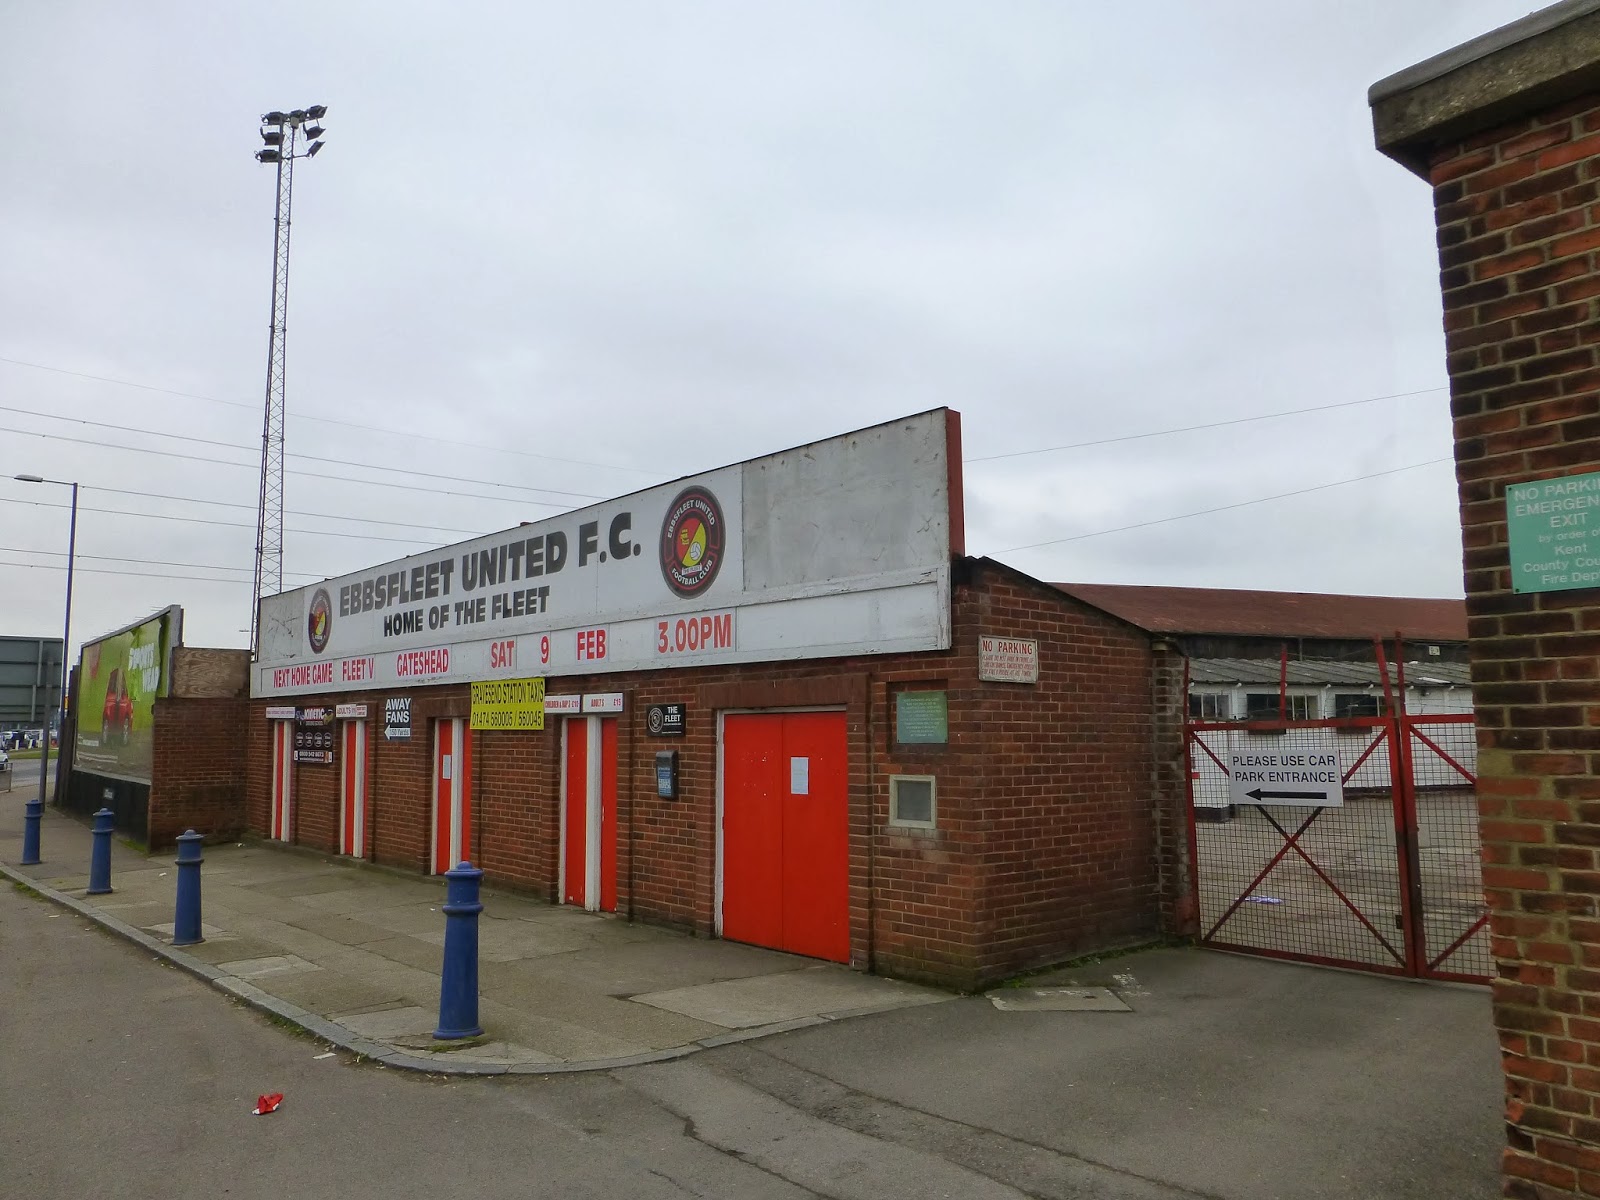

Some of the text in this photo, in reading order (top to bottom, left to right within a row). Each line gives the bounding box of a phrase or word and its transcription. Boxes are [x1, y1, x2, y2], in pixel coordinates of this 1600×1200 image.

[1514, 487, 1539, 501] NO
[667, 499, 715, 539] EBBSFLEET UNITED
[1549, 512, 1588, 528] EXIT
[1557, 529, 1587, 541] order
[1554, 543, 1588, 556] Kent
[340, 512, 641, 617] EBBSFLEET UNITED F.C.
[1523, 559, 1569, 574] County
[671, 559, 713, 586] FOOTBALL CLUB
[1541, 573, 1568, 585] Fire
[384, 585, 550, 637] HOME OF THE FLEET
[273, 668, 290, 689] NEXT
[291, 665, 311, 686] HOME
[312, 662, 333, 684] GAME
[342, 659, 366, 682] FLEET
[396, 648, 449, 677] GATESHEAD
[490, 640, 515, 669] SAT
[540, 635, 550, 664] 9
[577, 629, 606, 661] FEB
[657, 613, 732, 654] 3.00PM
[982, 640, 1032, 654] NO PARKING
[472, 680, 544, 705] GRAVESEND STATION TAXIS
[385, 698, 411, 711] AWAY
[667, 706, 678, 714] THE
[385, 711, 410, 723] FANS
[472, 711, 490, 727] 01474
[664, 714, 681, 723] FLEET
[1232, 755, 1336, 766] PLEASE USE CAR
[1234, 771, 1336, 783] PARK ENTRANCE
